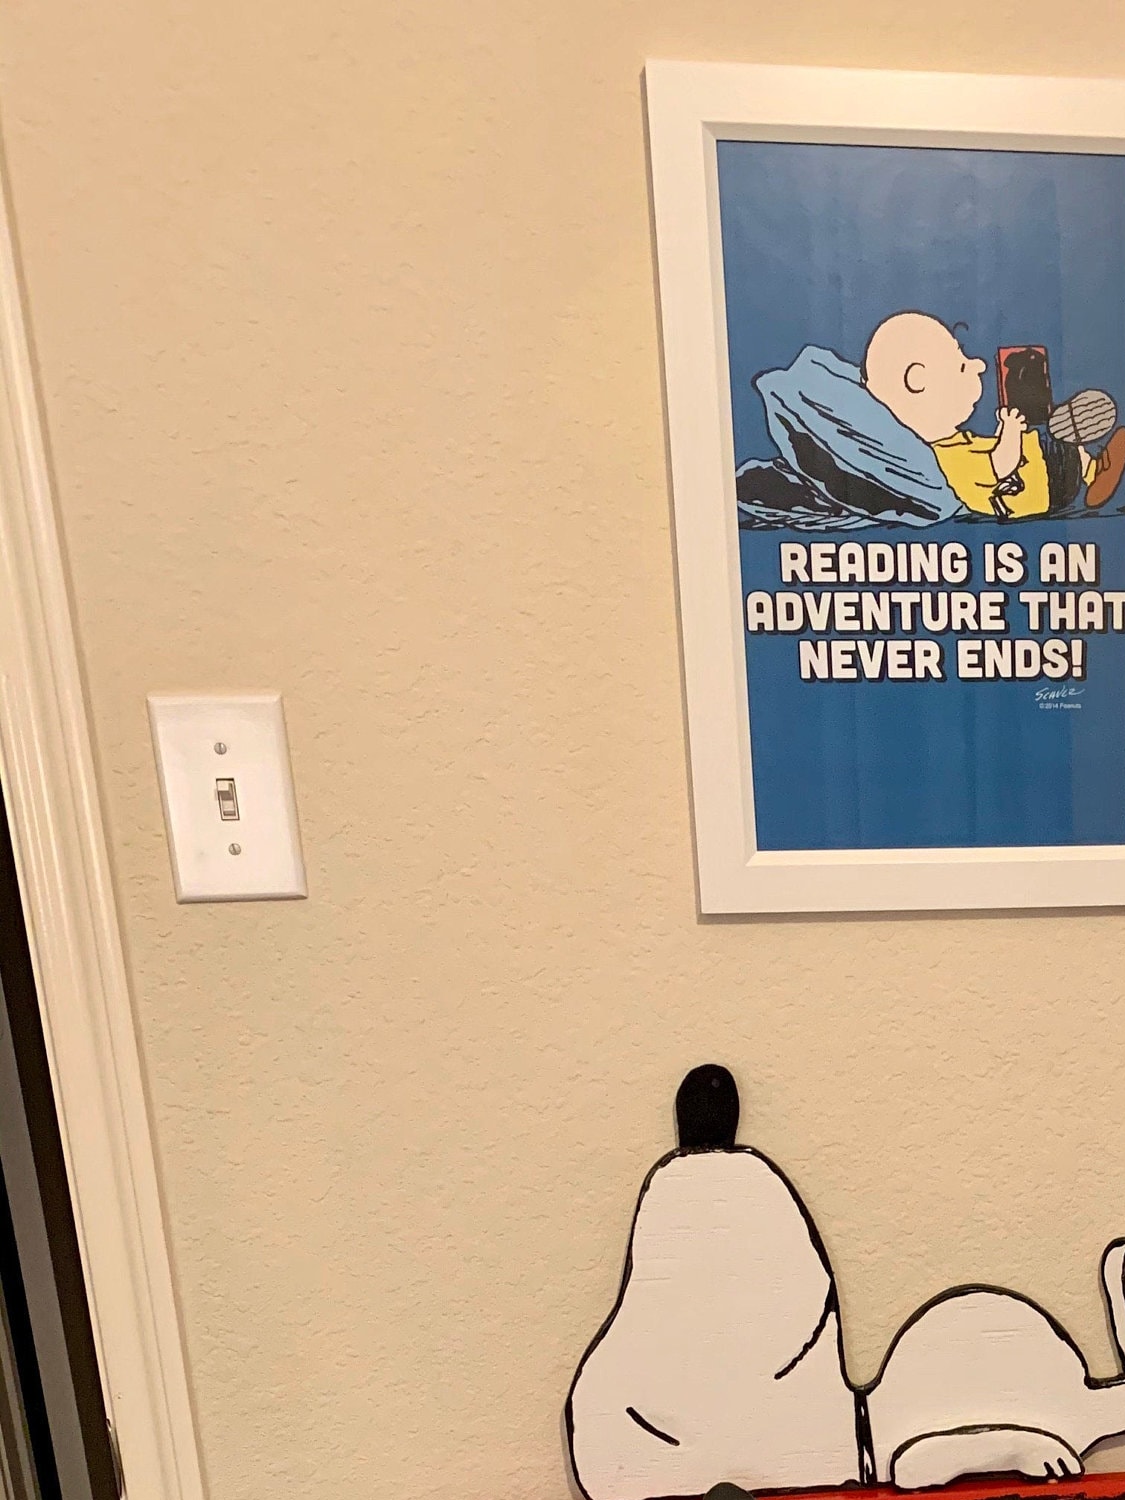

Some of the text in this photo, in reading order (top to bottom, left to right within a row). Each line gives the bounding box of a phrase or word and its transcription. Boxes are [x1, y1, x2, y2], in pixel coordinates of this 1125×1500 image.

[779, 541, 1097, 585] READING IS AN
[745, 590, 1006, 633] ADVENTURE
[798, 637, 1085, 680] NEVER ENDS!
